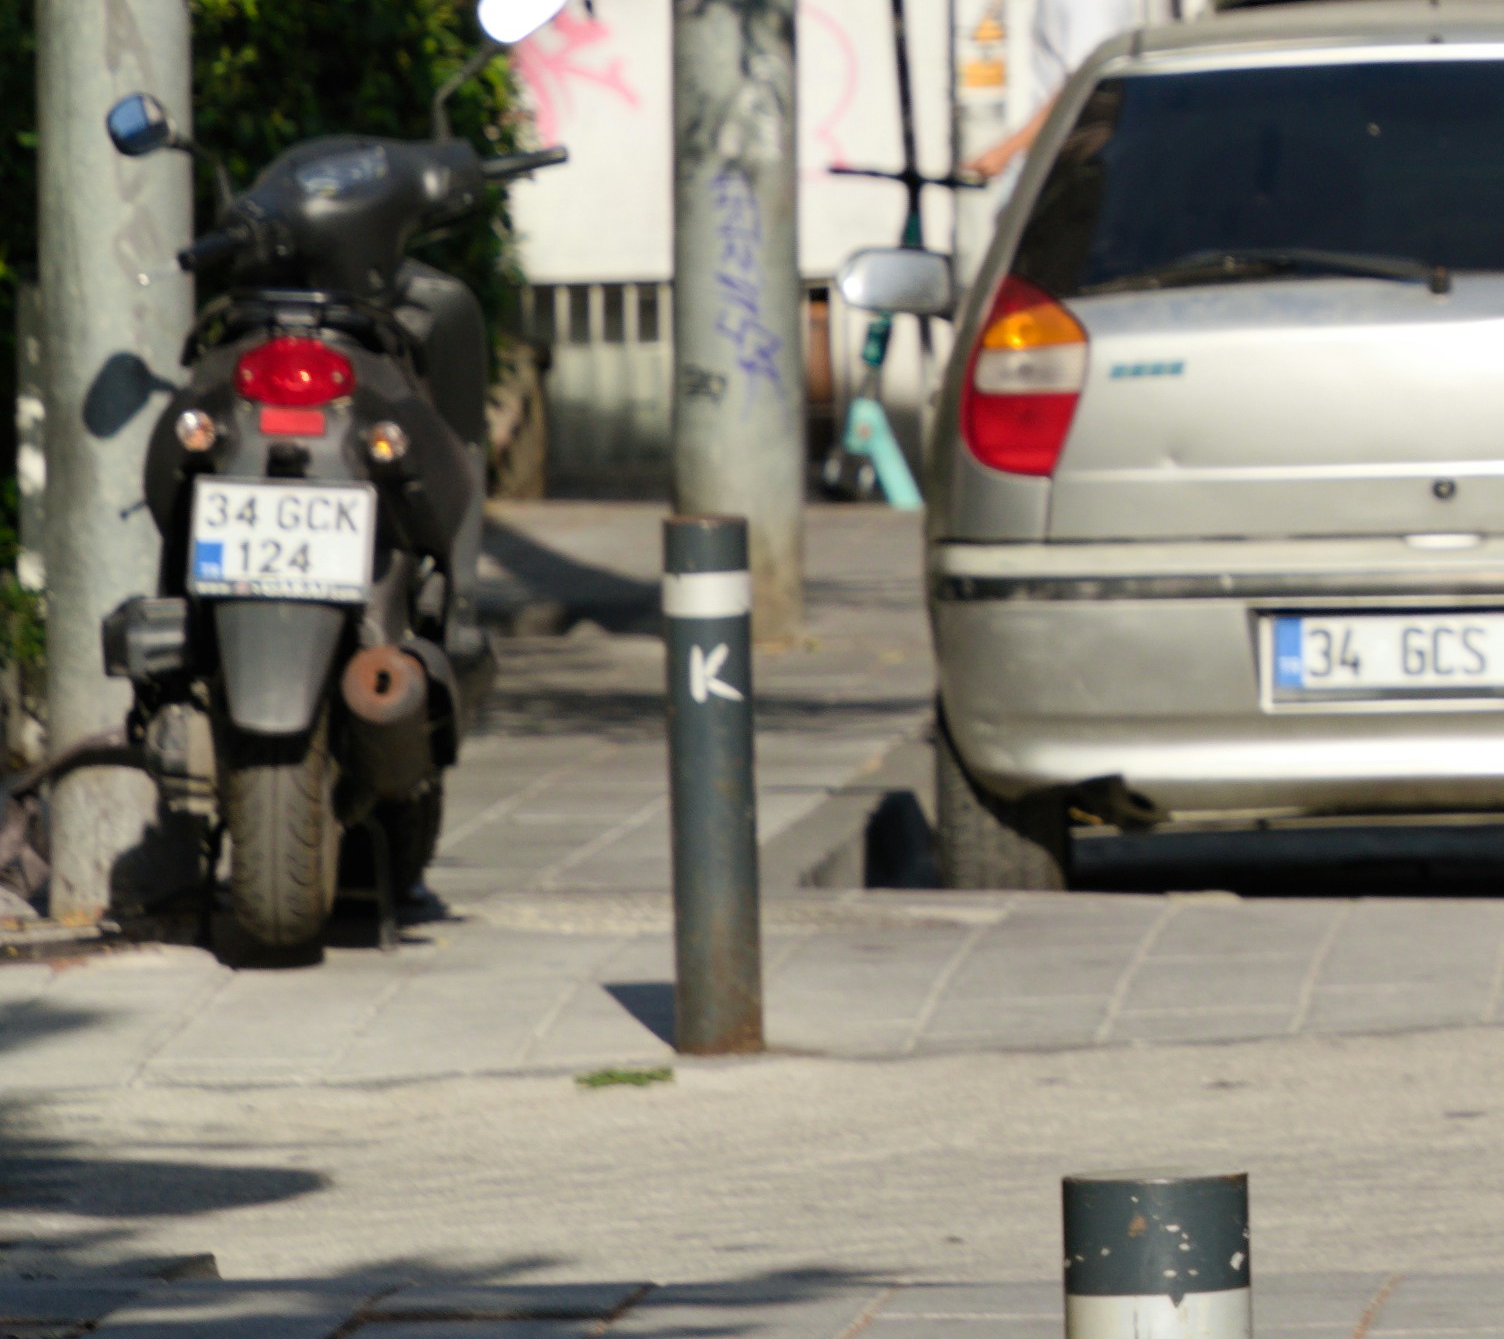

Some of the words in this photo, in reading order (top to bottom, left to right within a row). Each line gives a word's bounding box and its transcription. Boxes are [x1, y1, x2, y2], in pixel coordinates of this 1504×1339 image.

[206, 491, 257, 531] 34
[276, 493, 359, 534] GCK
[238, 538, 311, 574] 124
[688, 642, 745, 704] K
[1308, 627, 1361, 678] 34
[1401, 626, 1487, 678] GCS
